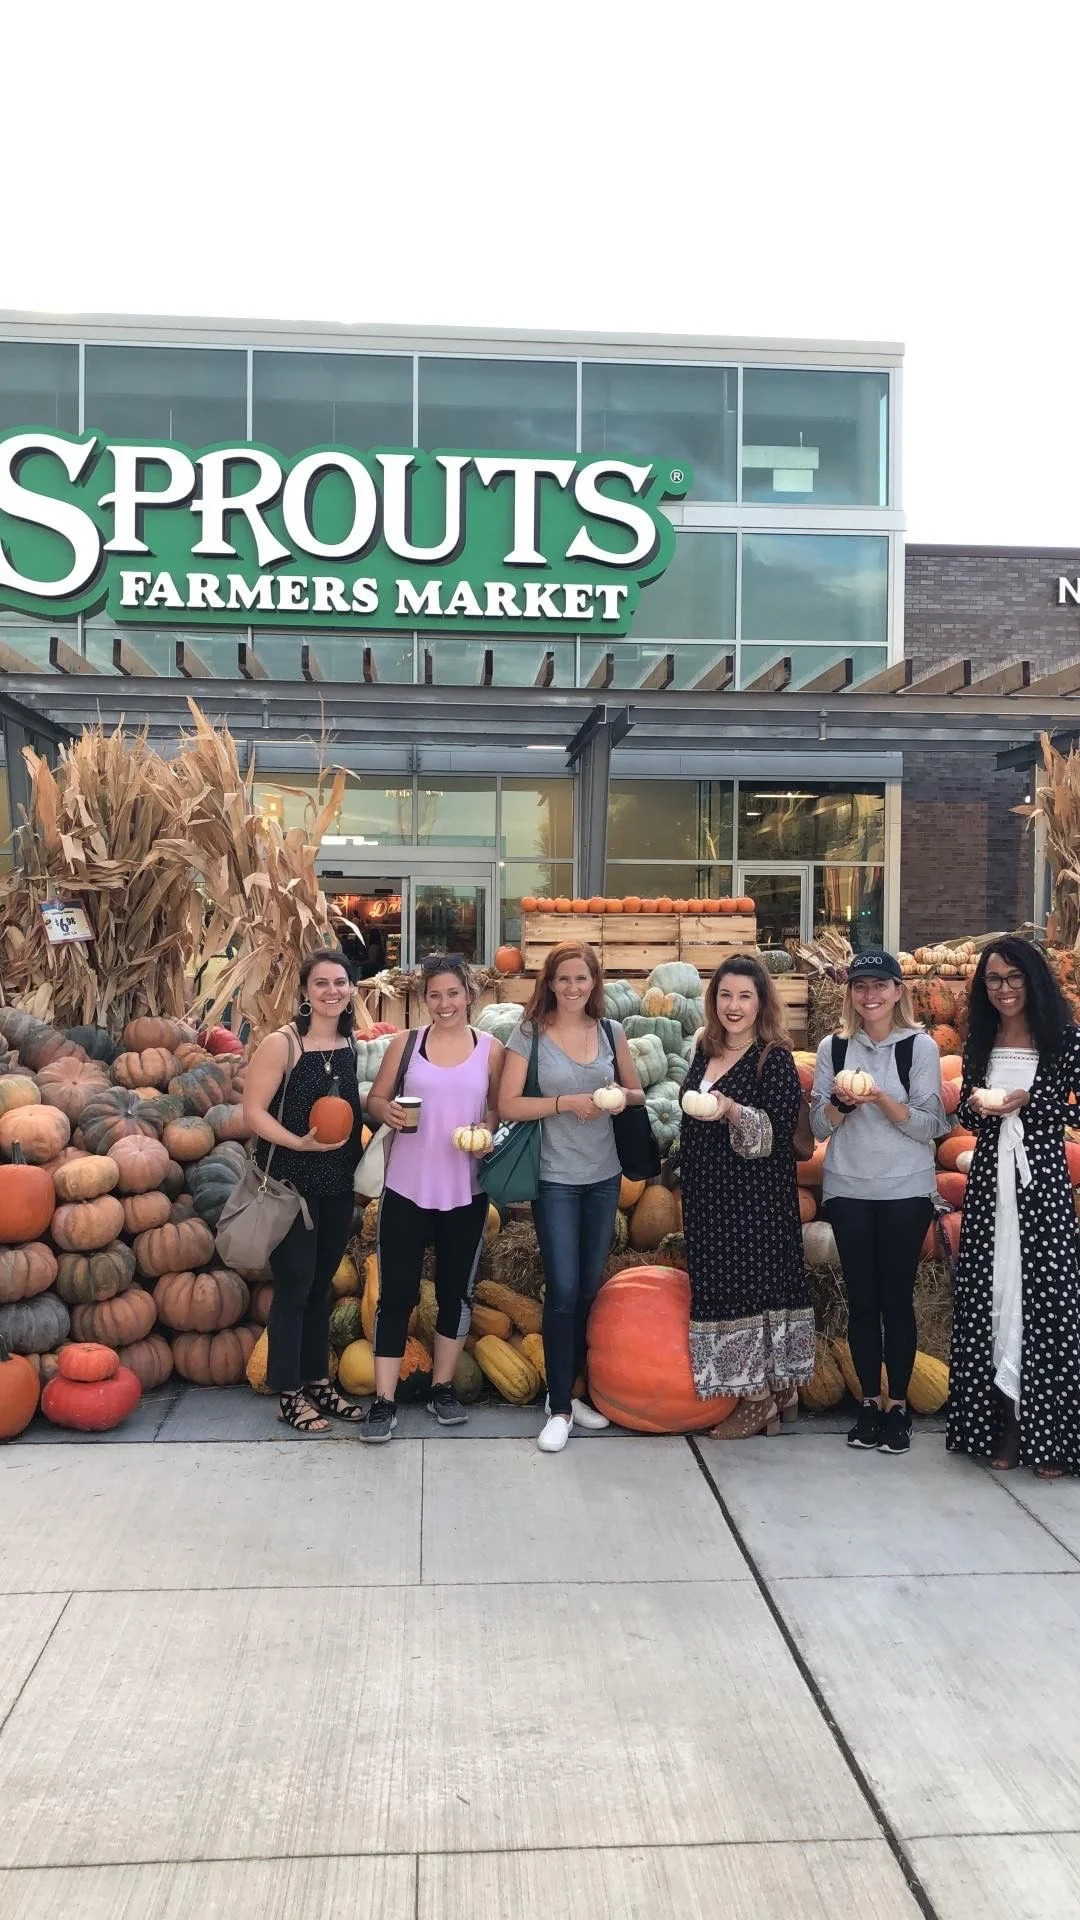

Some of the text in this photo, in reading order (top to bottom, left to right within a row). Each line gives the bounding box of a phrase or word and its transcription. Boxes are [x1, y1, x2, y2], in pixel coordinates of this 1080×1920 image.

[0, 432, 656, 597] SPROUTS
[119, 571, 628, 619] FARMERS MARKET
[854, 957, 882, 967] GOOD
